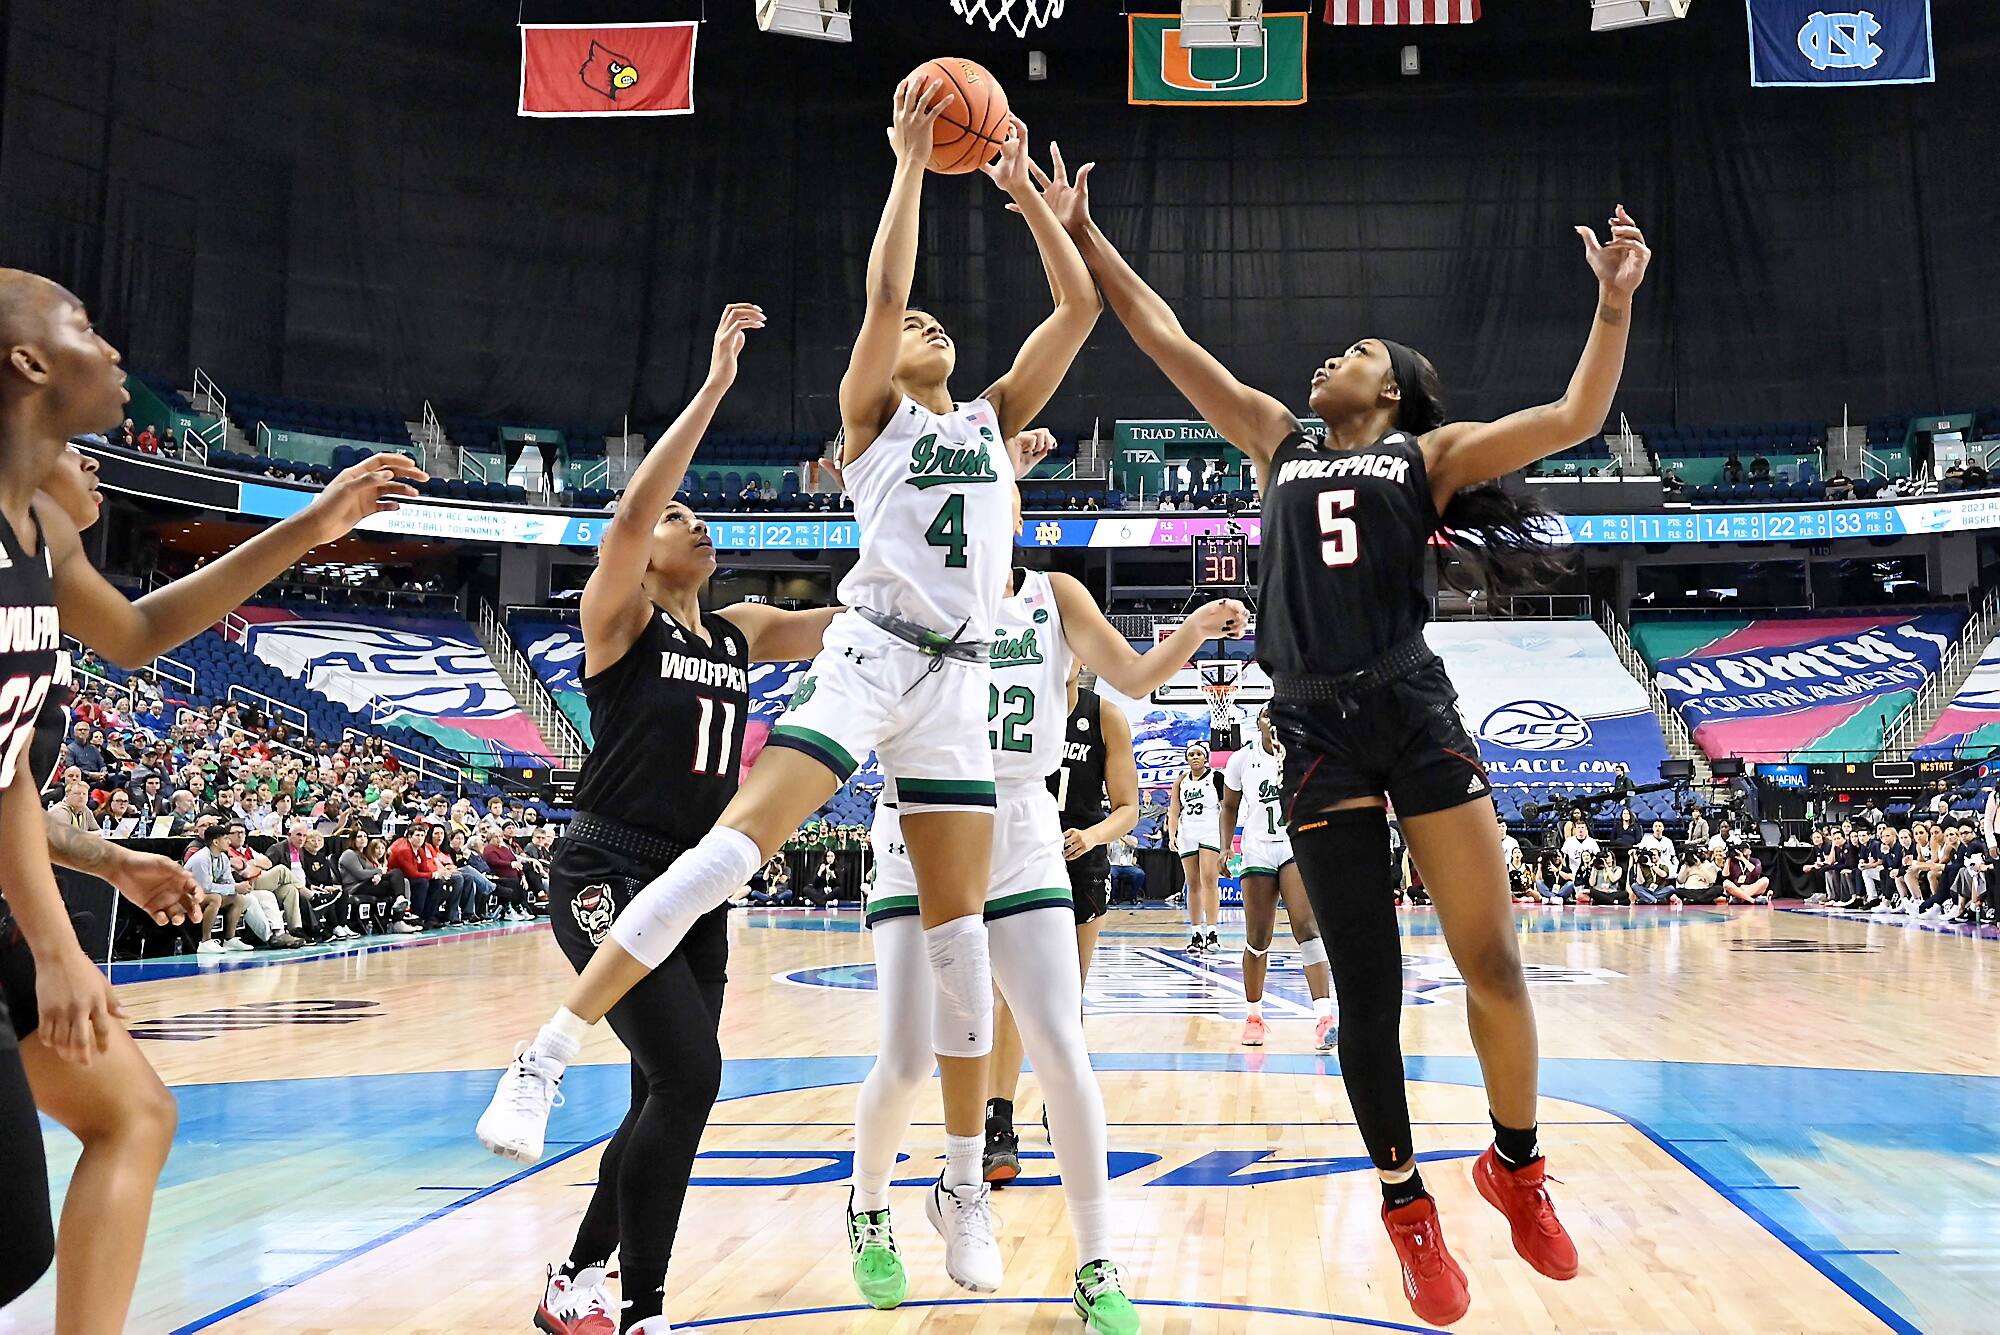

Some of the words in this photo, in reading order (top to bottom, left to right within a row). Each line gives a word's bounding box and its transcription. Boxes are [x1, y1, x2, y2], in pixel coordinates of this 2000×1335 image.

[1130, 427, 1176, 440] TRIAD
[909, 433, 997, 476] Irish
[1122, 450, 1161, 463] TFA
[1276, 454, 1410, 486] WOLFPACK
[1961, 502, 1985, 513] 2023
[1751, 516, 1758, 527] 0
[1817, 513, 1825, 524] 0
[1884, 510, 1892, 521] 0
[388, 519, 442, 532] BASKETBALL
[1316, 488, 1359, 569] 5
[1620, 518, 1628, 529] 0
[1639, 519, 1660, 539] 11
[1686, 517, 1693, 528] 6
[1705, 518, 1730, 538] 14
[1768, 516, 1795, 537] 22
[1834, 513, 1862, 534] 33
[1885, 522, 1893, 533] 0
[577, 522, 591, 542] 5
[749, 526, 755, 535] 2
[766, 526, 792, 546] 22
[813, 526, 820, 535] 2
[829, 526, 851, 545] 41
[925, 494, 967, 568] 4
[1579, 520, 1593, 539] 4
[1620, 530, 1628, 540] 0
[1686, 529, 1693, 540] 0
[1751, 528, 1759, 539] 0
[1818, 525, 1825, 536] 0
[749, 537, 755, 547] 0
[814, 537, 818, 546] 1
[1205, 556, 1236, 581] 30
[1681, 659, 1928, 715] TOURNAMENT
[1500, 723, 1585, 735] ACC
[692, 696, 736, 776] 11
[1761, 774, 1806, 787] UAFINA
[1186, 802, 1204, 816] 33
